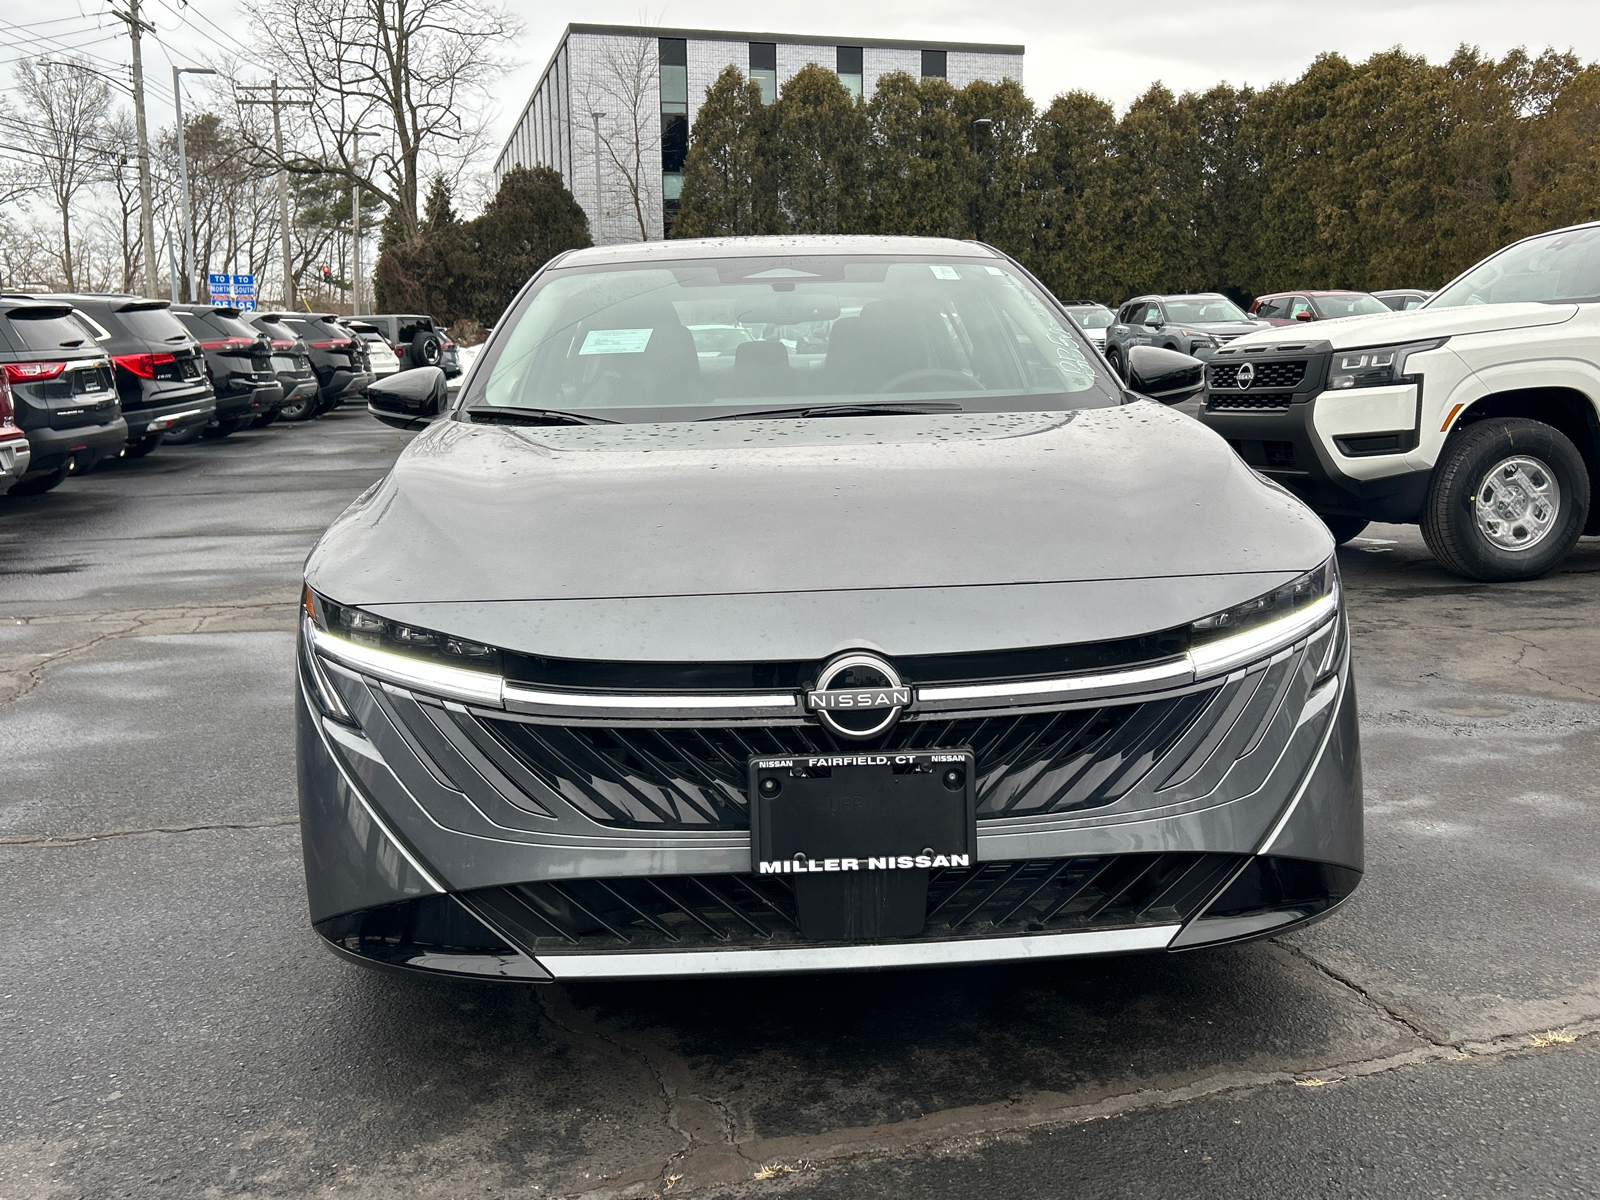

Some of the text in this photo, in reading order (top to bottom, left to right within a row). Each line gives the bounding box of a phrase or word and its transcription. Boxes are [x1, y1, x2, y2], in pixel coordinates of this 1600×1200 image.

[214, 275, 225, 283] TO
[235, 286, 254, 294] SOUTH
[811, 691, 908, 707] NISSAN
[808, 755, 916, 767] FAIRFIELD, CT
[931, 755, 965, 763] NISSAN
[759, 760, 793, 768] NISSAN
[759, 854, 969, 874] MILLER NISSAN
